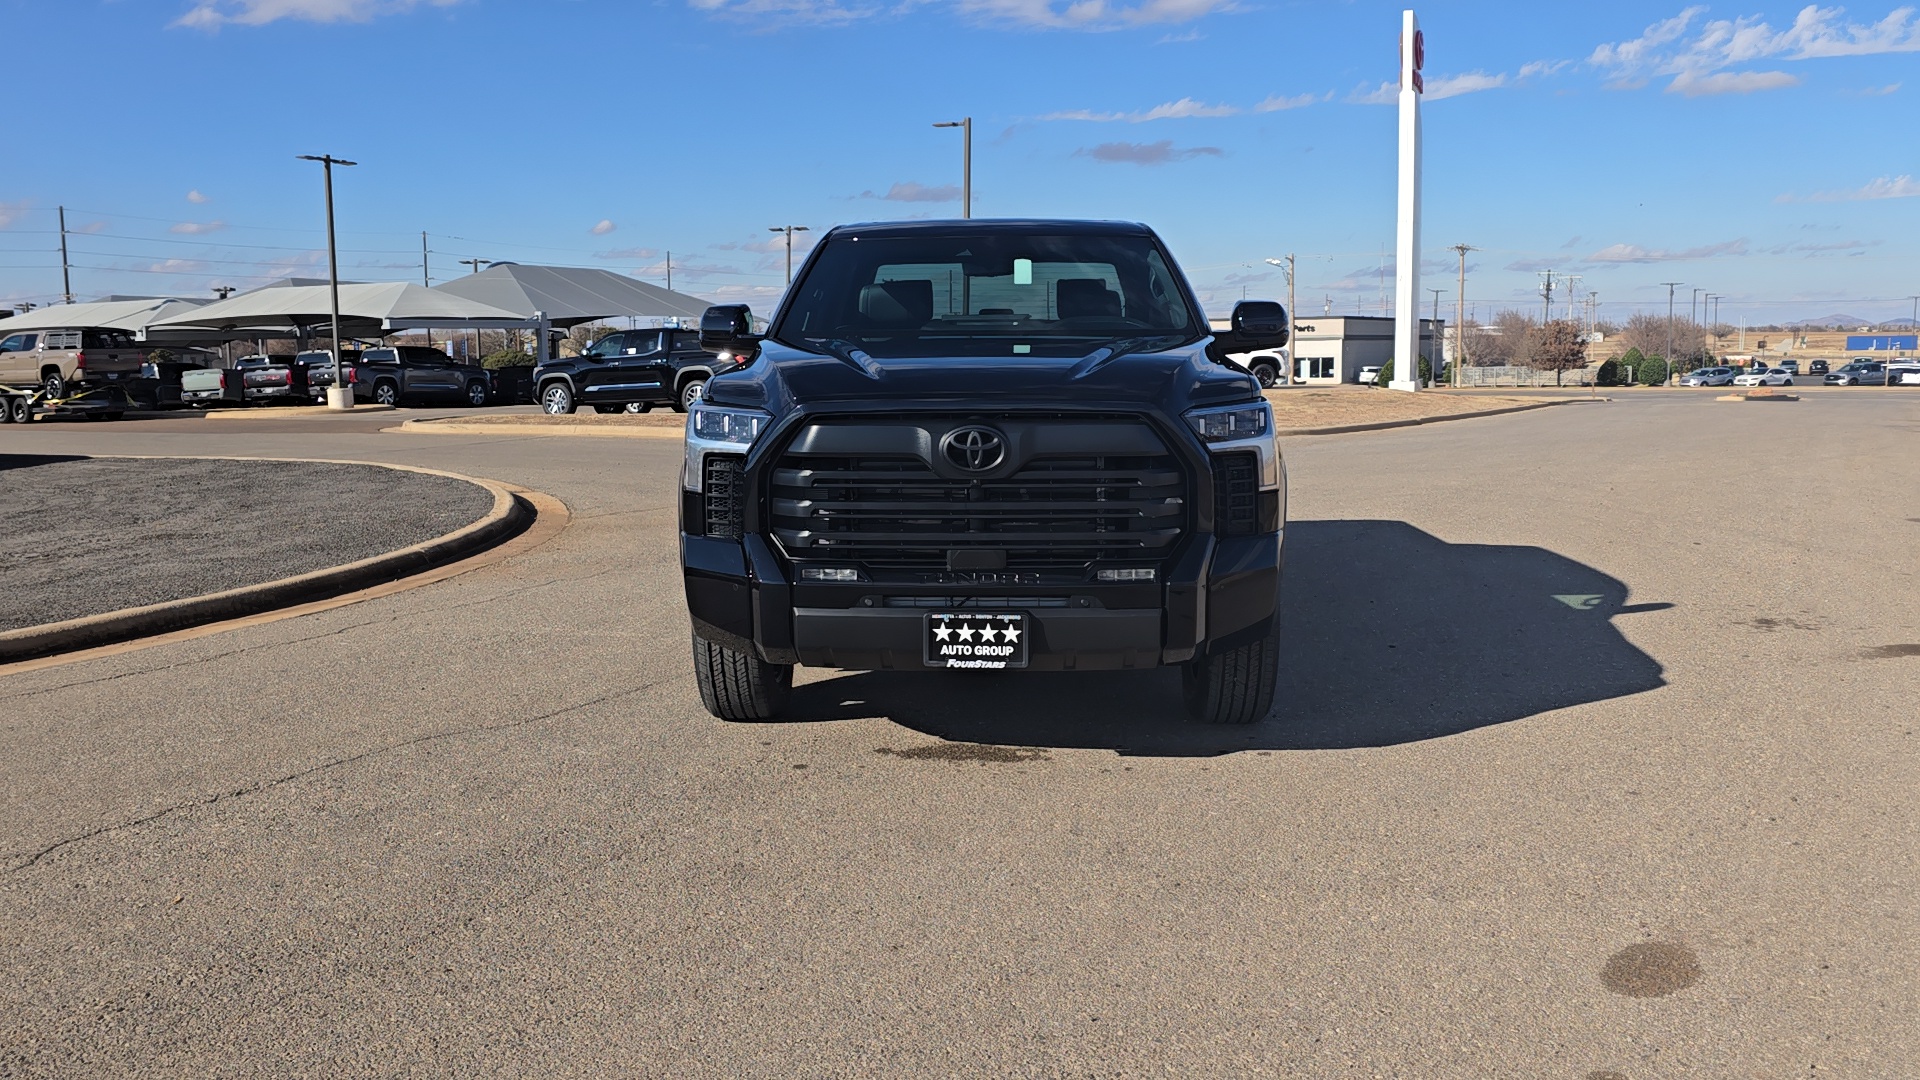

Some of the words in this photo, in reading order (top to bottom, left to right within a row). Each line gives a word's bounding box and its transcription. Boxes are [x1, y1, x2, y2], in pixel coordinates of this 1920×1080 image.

[915, 572, 1040, 585] TUNDRA
[940, 644, 972, 655] AUTO
[974, 645, 1014, 656] GROUP
